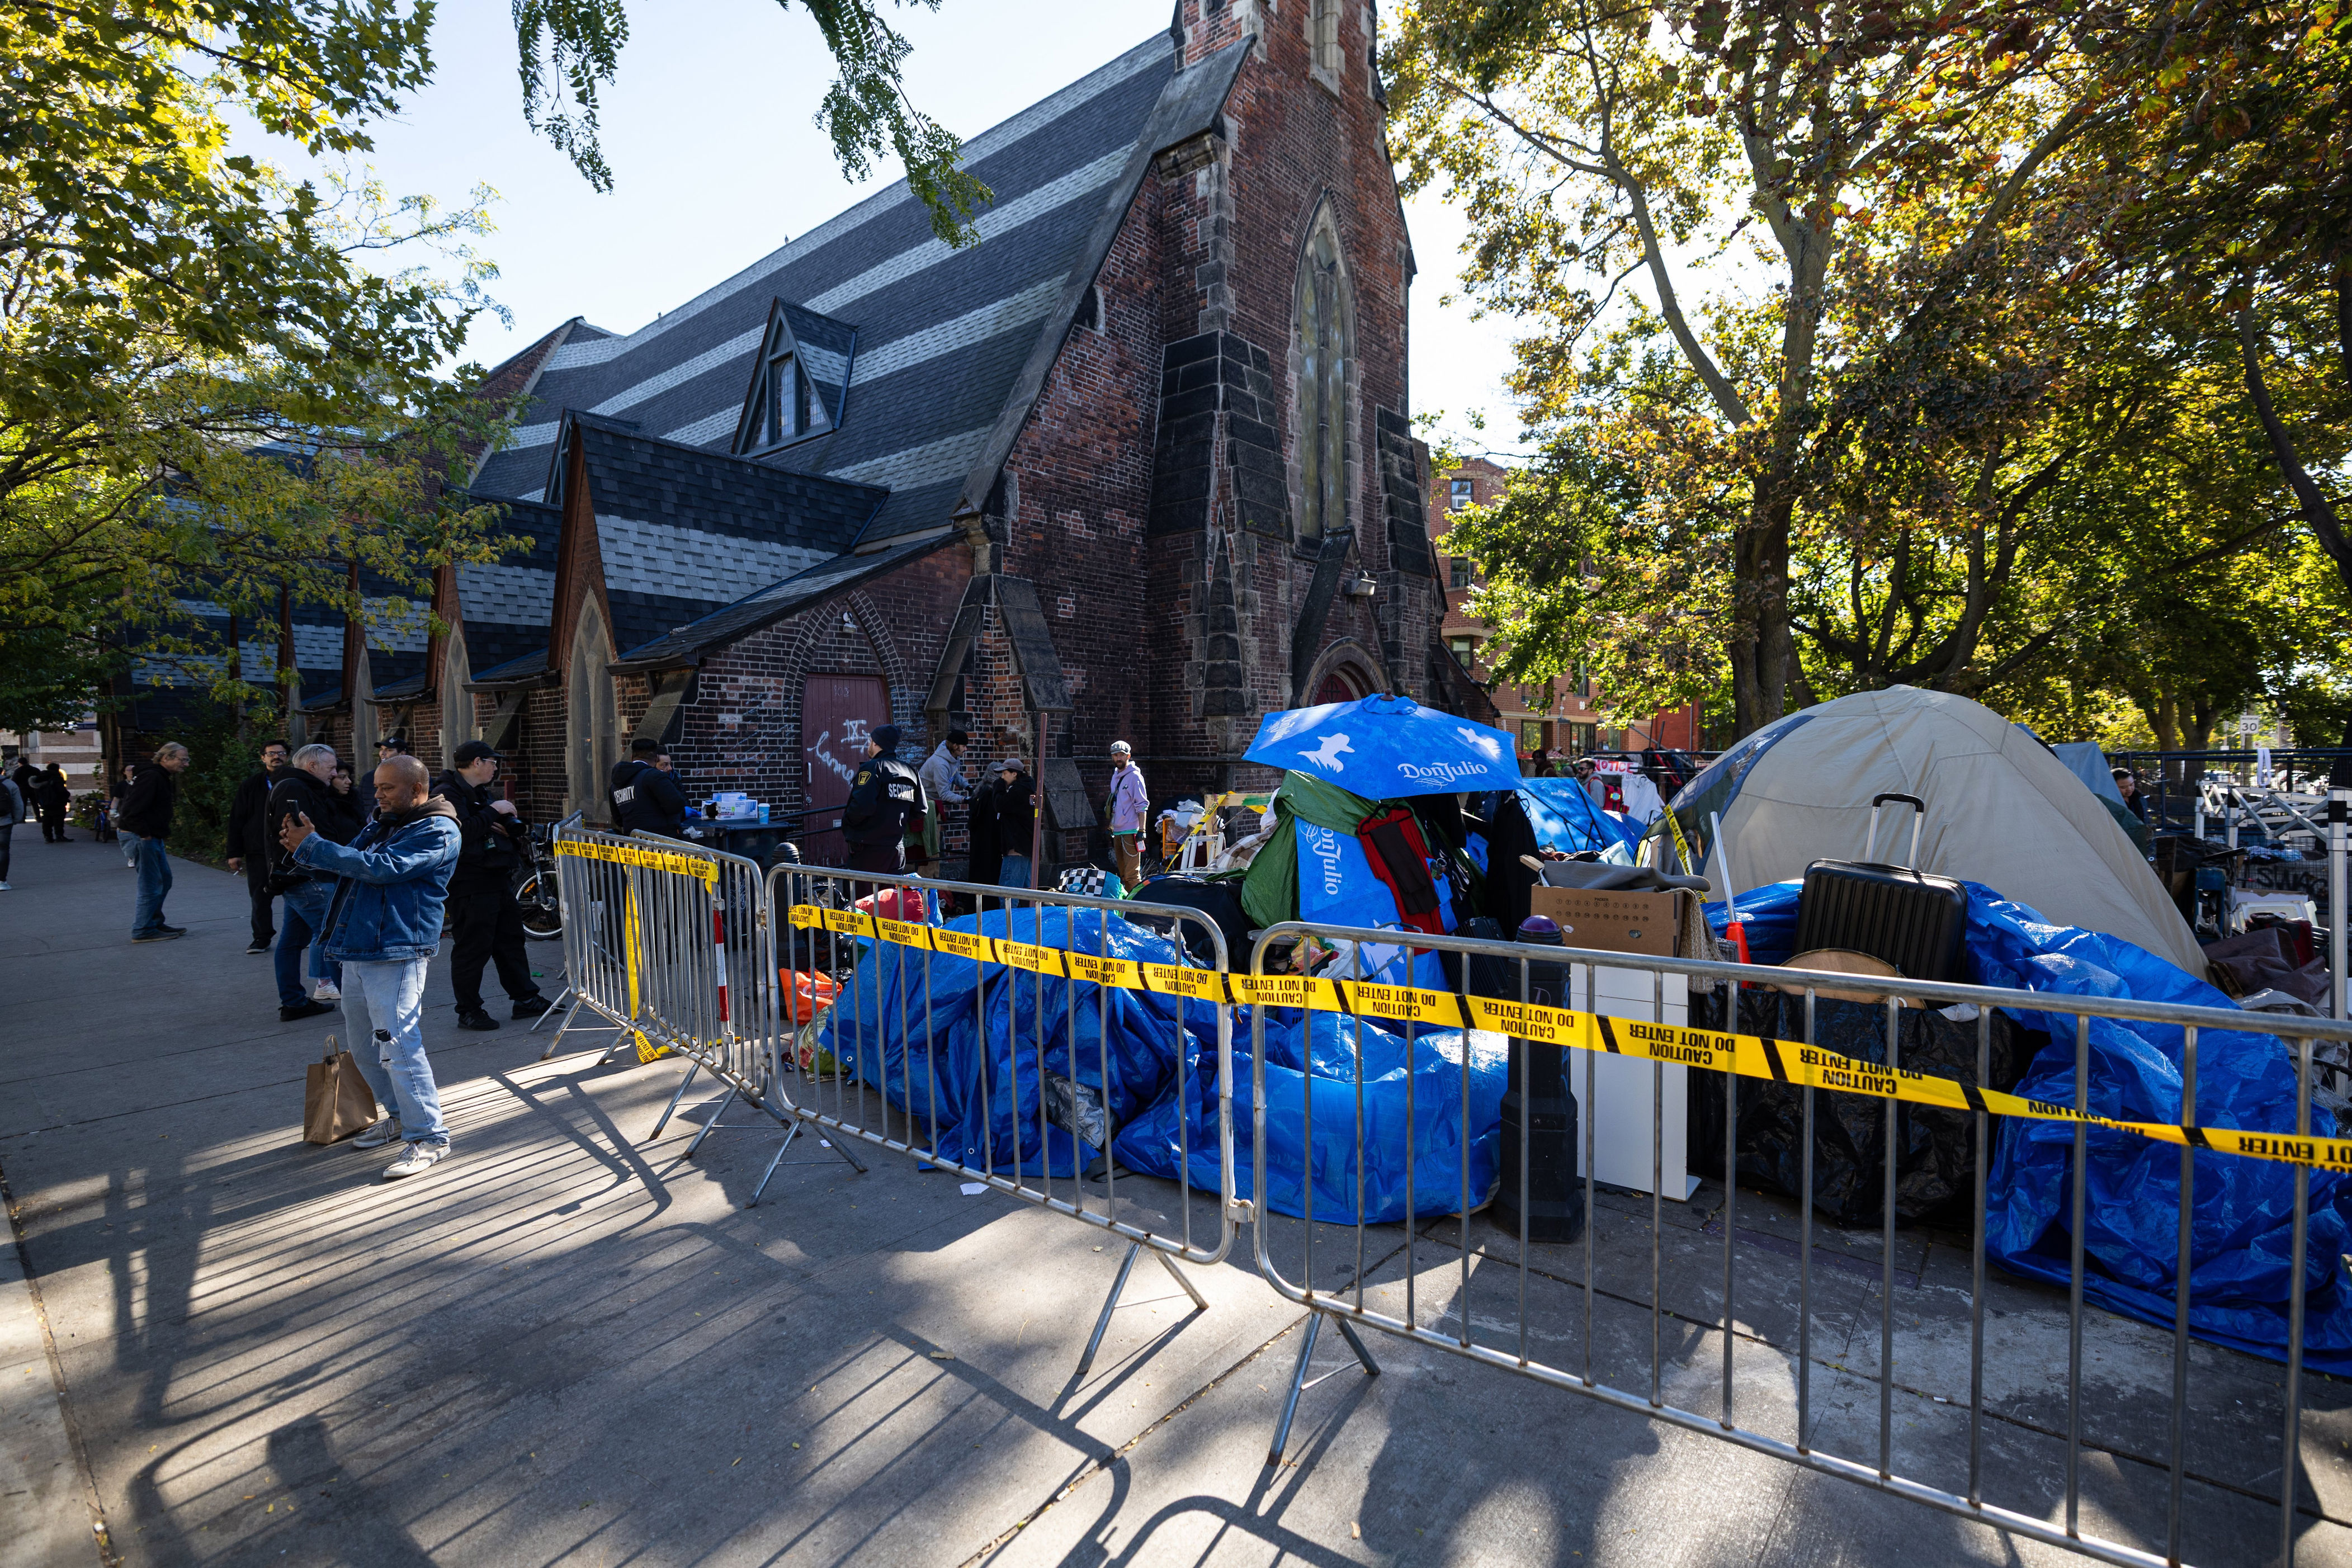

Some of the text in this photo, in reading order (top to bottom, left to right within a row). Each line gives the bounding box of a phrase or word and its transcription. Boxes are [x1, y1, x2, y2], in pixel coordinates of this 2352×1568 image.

[1594, 759, 1634, 773] NOTICE
[614, 786, 634, 804] SECURITY
[889, 783, 914, 800] SECURITY
[1312, 827, 1342, 895] onJulio
[830, 911, 863, 925] DO NOT ENTER
[837, 922, 857, 933] CAUTION
[882, 921, 918, 936] DO NOT ENTER
[889, 932, 911, 944] CAUTION
[939, 931, 980, 947] DO NOT ENTER
[947, 943, 972, 956] CAUTION
[1003, 943, 1048, 960] DO NOT ENTER
[1012, 956, 1039, 969] CAUTION
[1075, 956, 1125, 974] DO NOT ENTER
[1085, 969, 1115, 984] CAUTION
[1154, 967, 1208, 985] DO NOT ENTER
[1165, 980, 1196, 995] CAUTION
[1241, 979, 1316, 993] DO NOT ENTER
[1257, 992, 1302, 1004] CAUTION
[1358, 986, 1436, 1007] DO NOT ENTER
[1373, 1002, 1420, 1017] CAUTION
[1484, 1002, 1574, 1028] DO NOT ENTER
[1501, 1019, 1555, 1040] CAUTION
[1630, 1023, 1736, 1052] DO NOT ENTER
[637, 1036, 650, 1051] ENTER
[1650, 1042, 1713, 1065] CAUTION
[1800, 1049, 1852, 1070] ENTER
[1822, 1069, 1897, 1094] CAUTION
[2238, 1136, 2352, 1165] OT ENTER
